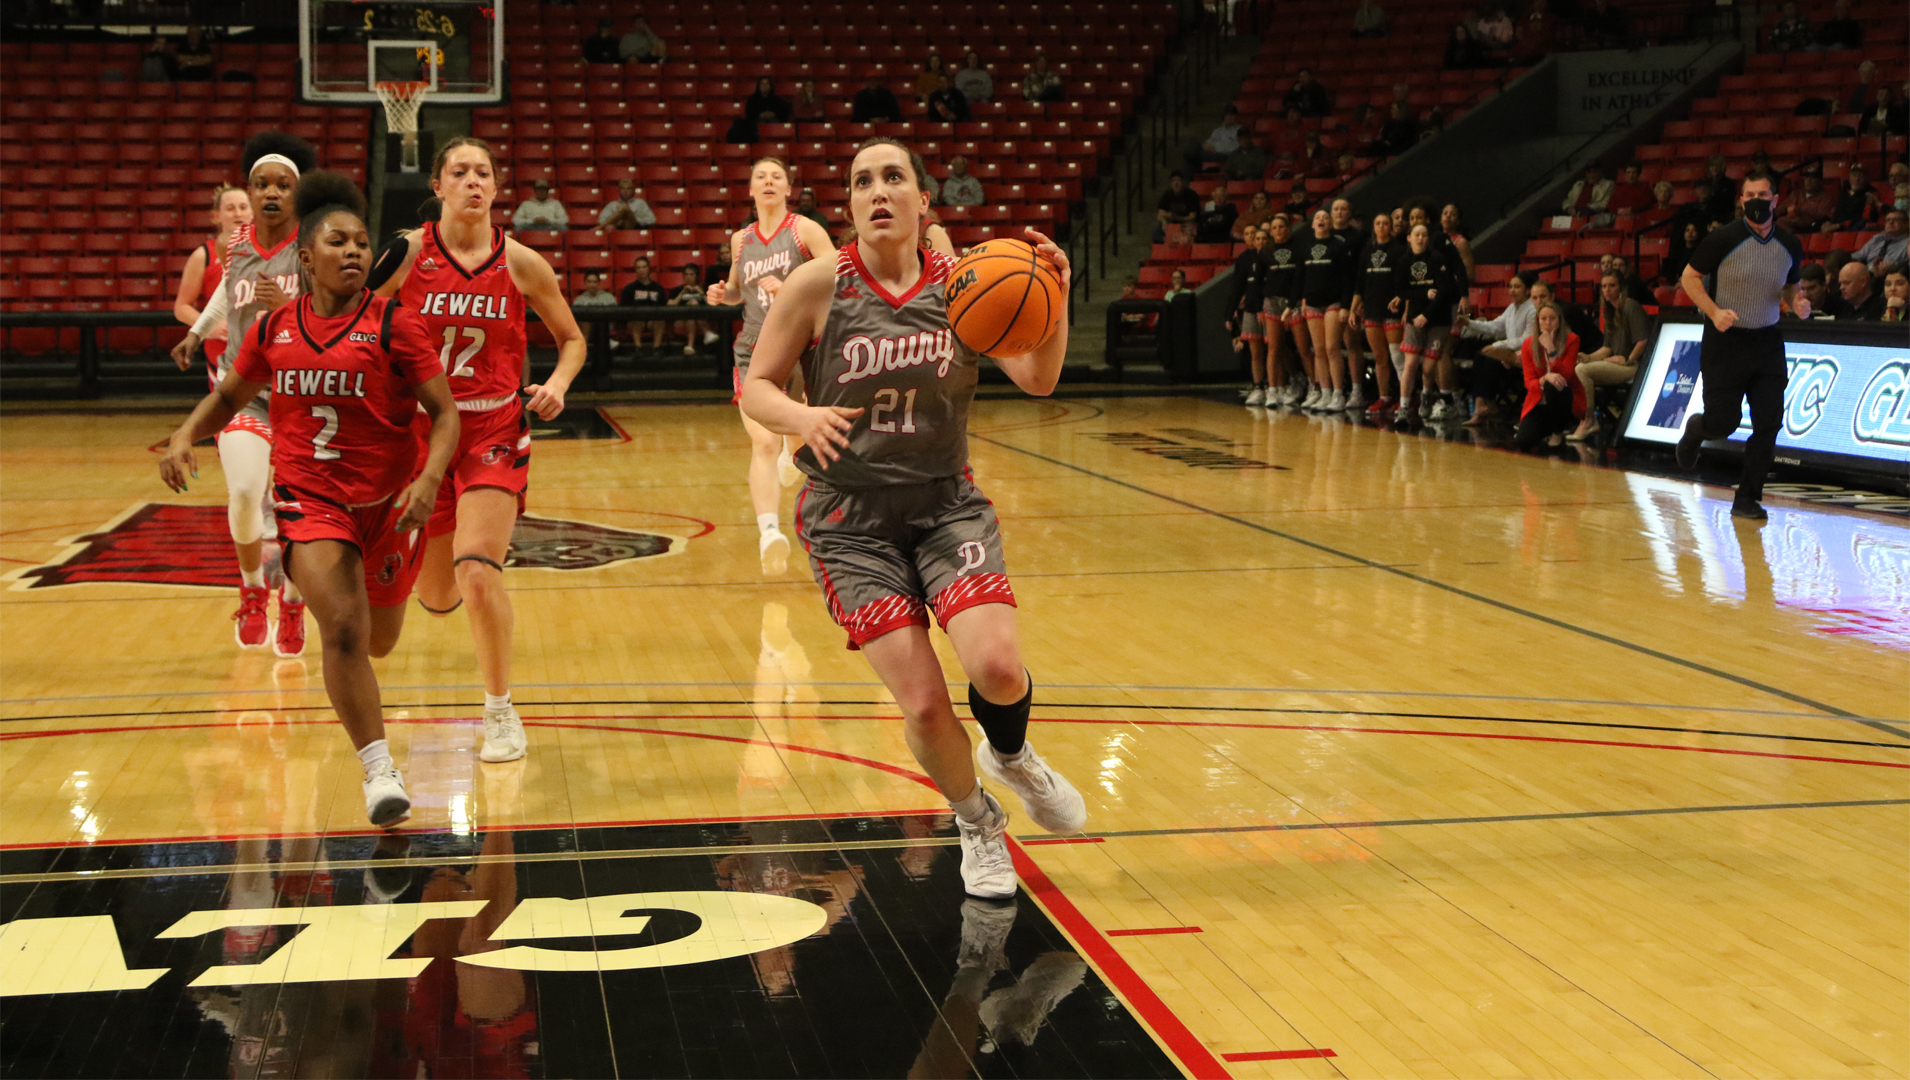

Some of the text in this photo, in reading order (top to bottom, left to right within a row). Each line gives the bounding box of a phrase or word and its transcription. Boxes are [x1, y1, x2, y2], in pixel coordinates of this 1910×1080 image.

[1582, 96, 1601, 110] IN
[744, 250, 791, 284] Drury
[234, 273, 299, 309] Dry
[419, 291, 508, 320] JEWELL
[349, 331, 378, 344] GLVC
[438, 325, 486, 378] 12
[837, 327, 955, 384] Drury
[276, 368, 366, 398] JEWELL
[870, 387, 918, 434] 21
[311, 404, 341, 460] 2
[956, 541, 987, 578] D
